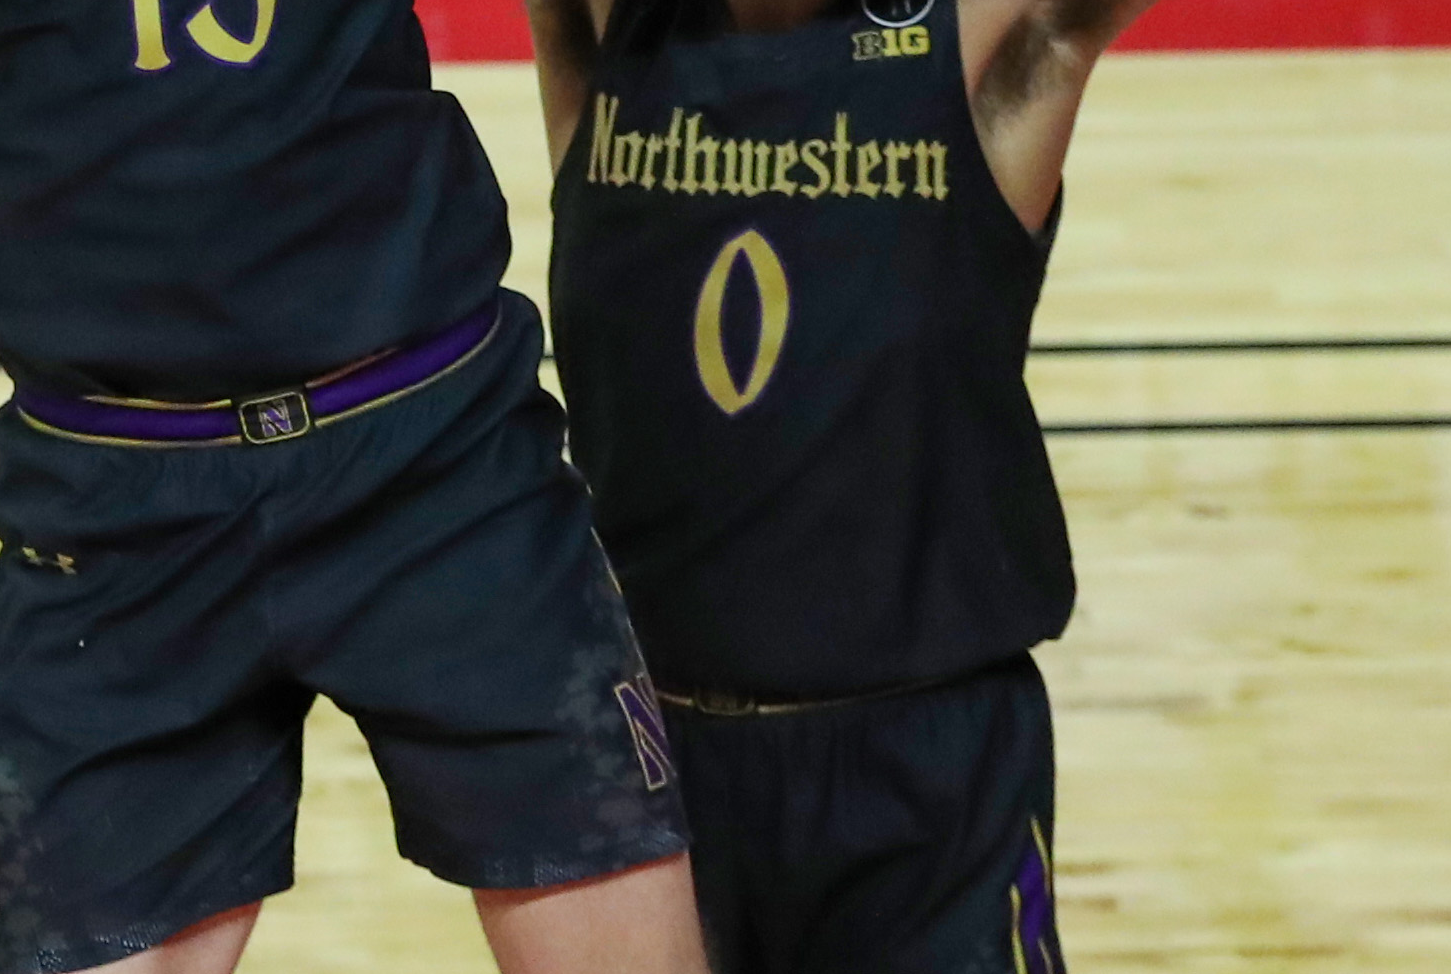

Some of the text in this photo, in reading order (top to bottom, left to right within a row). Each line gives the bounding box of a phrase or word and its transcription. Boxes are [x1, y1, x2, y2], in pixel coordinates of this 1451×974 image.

[587, 92, 949, 201] Northwestern
[693, 227, 791, 416] 0
[257, 398, 293, 437] N
